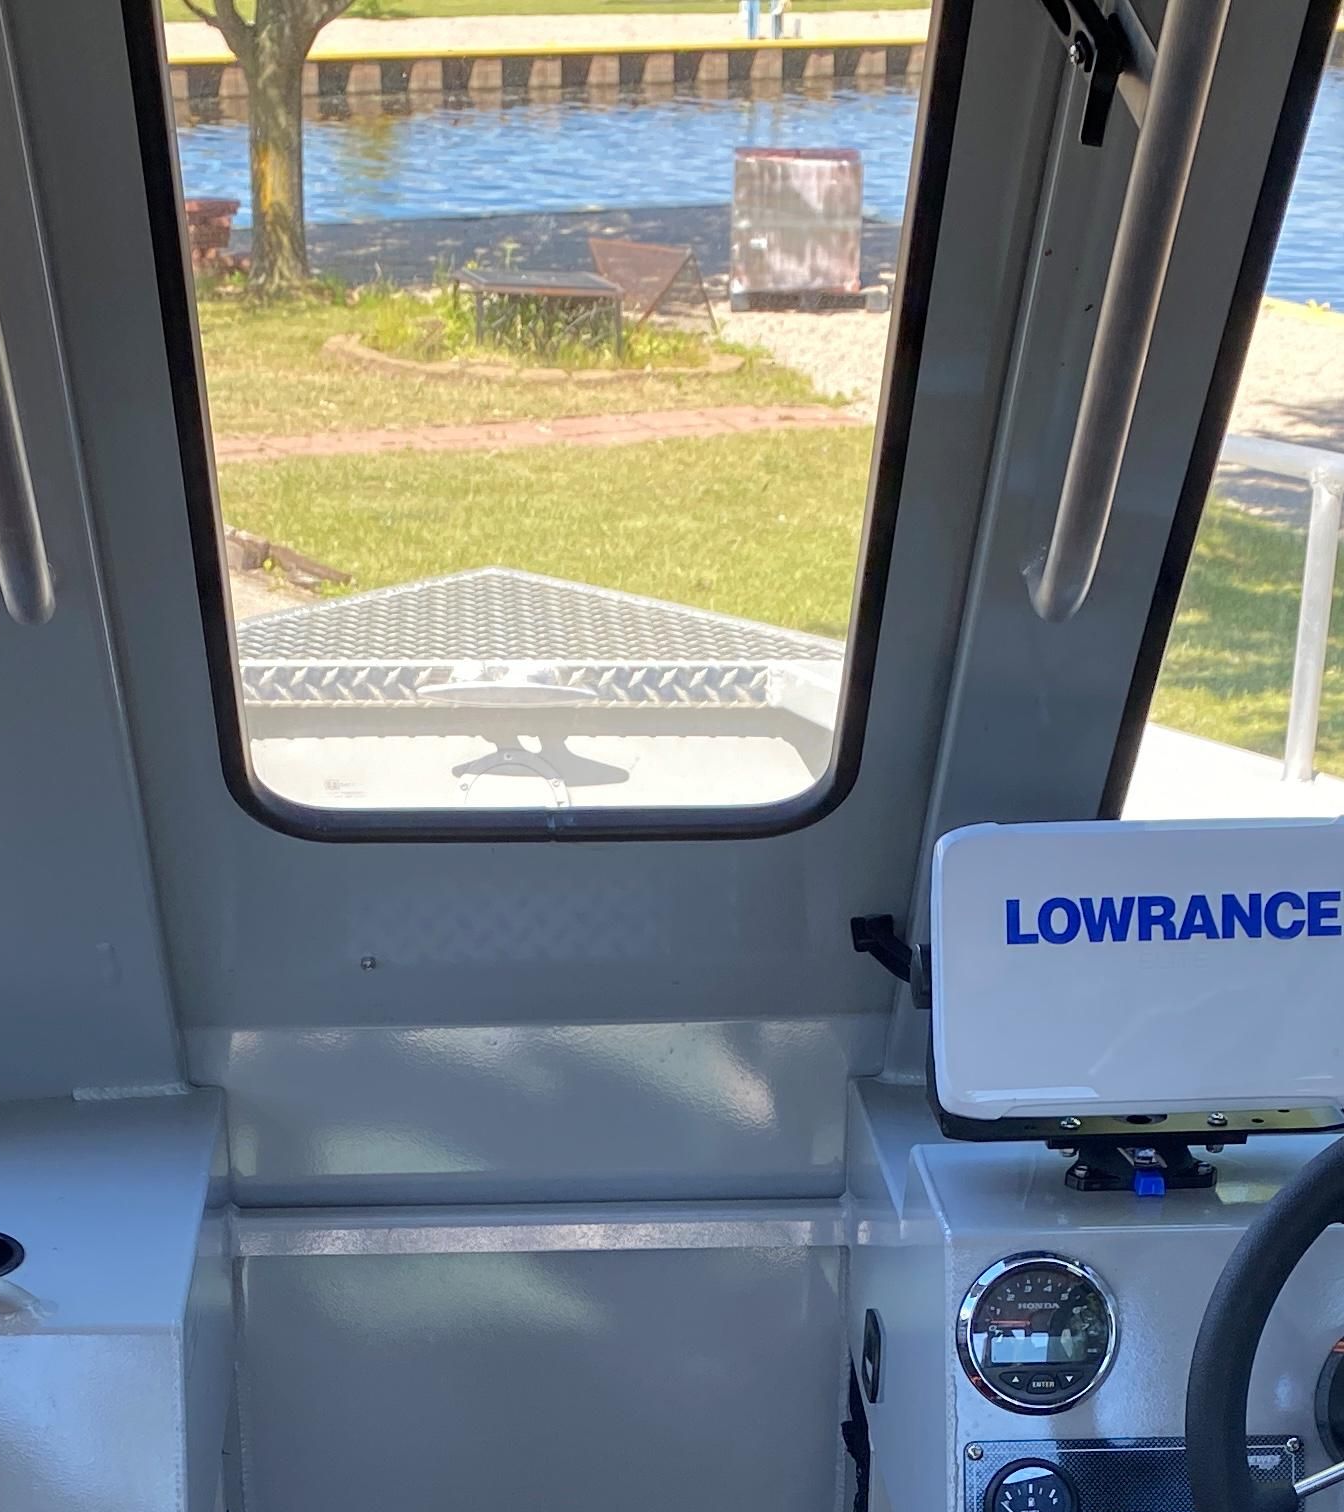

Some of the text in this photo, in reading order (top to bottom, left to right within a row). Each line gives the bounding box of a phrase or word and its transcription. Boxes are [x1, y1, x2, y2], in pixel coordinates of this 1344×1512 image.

[1006, 891, 1342, 944] LOWRANCE
[1043, 1285, 1052, 1293] 4
[1017, 1302, 1060, 1310] HONDA
[1032, 1380, 1056, 1388] ENTER
